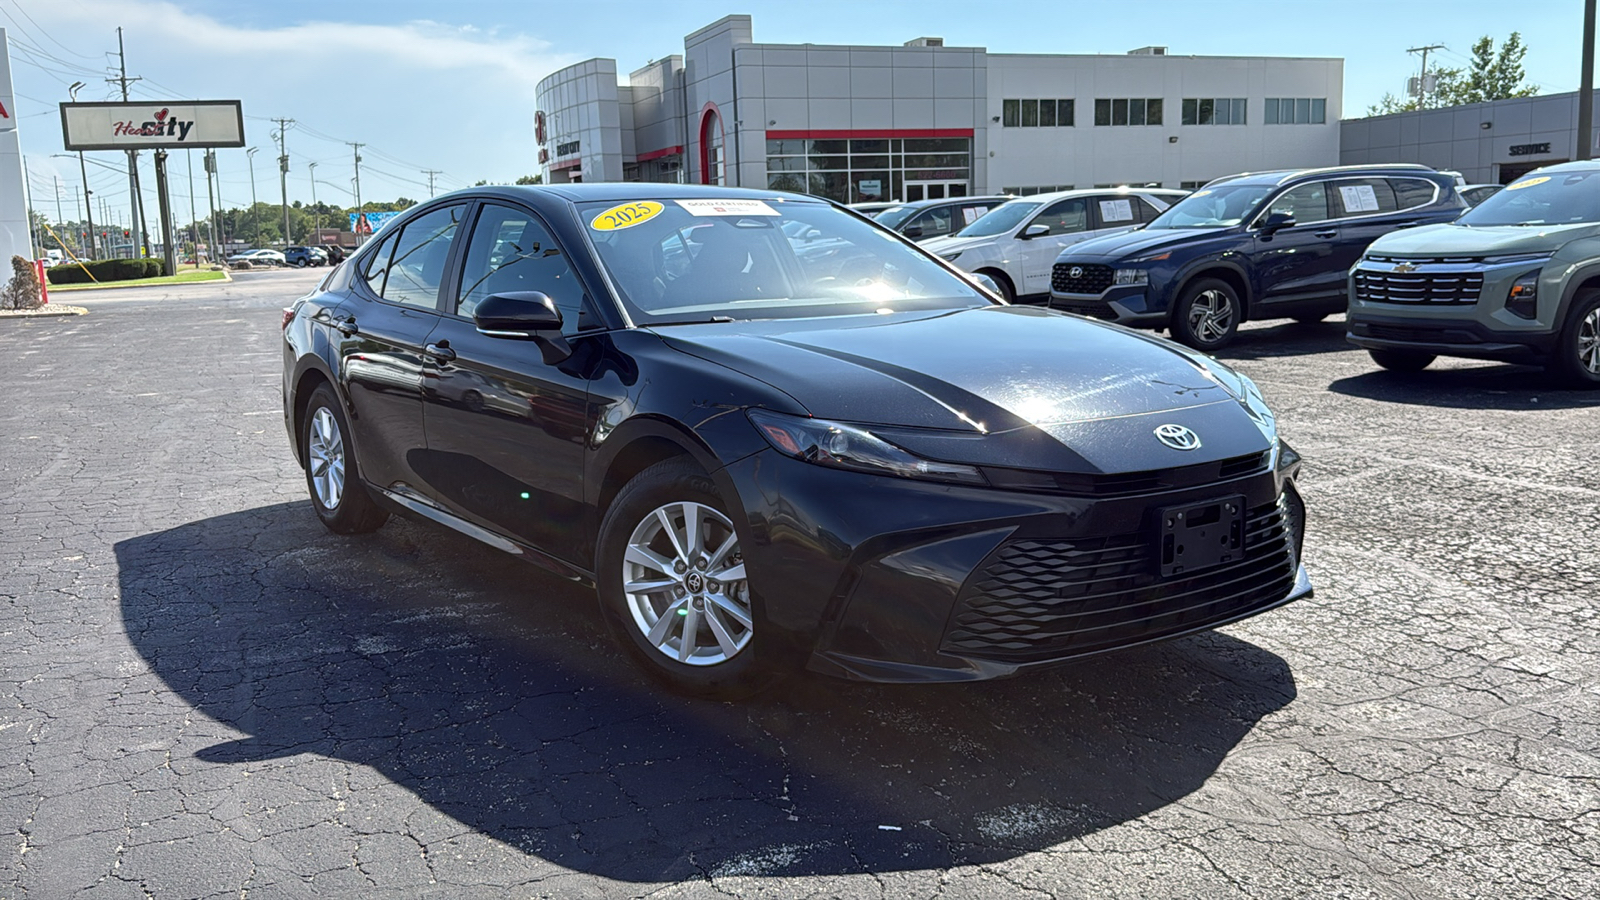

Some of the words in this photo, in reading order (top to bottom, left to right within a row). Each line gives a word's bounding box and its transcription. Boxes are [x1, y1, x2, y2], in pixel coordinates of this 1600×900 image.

[113, 121, 170, 136] Heart
[1509, 142, 1551, 156] SERVICE
[604, 203, 651, 227] 2025
